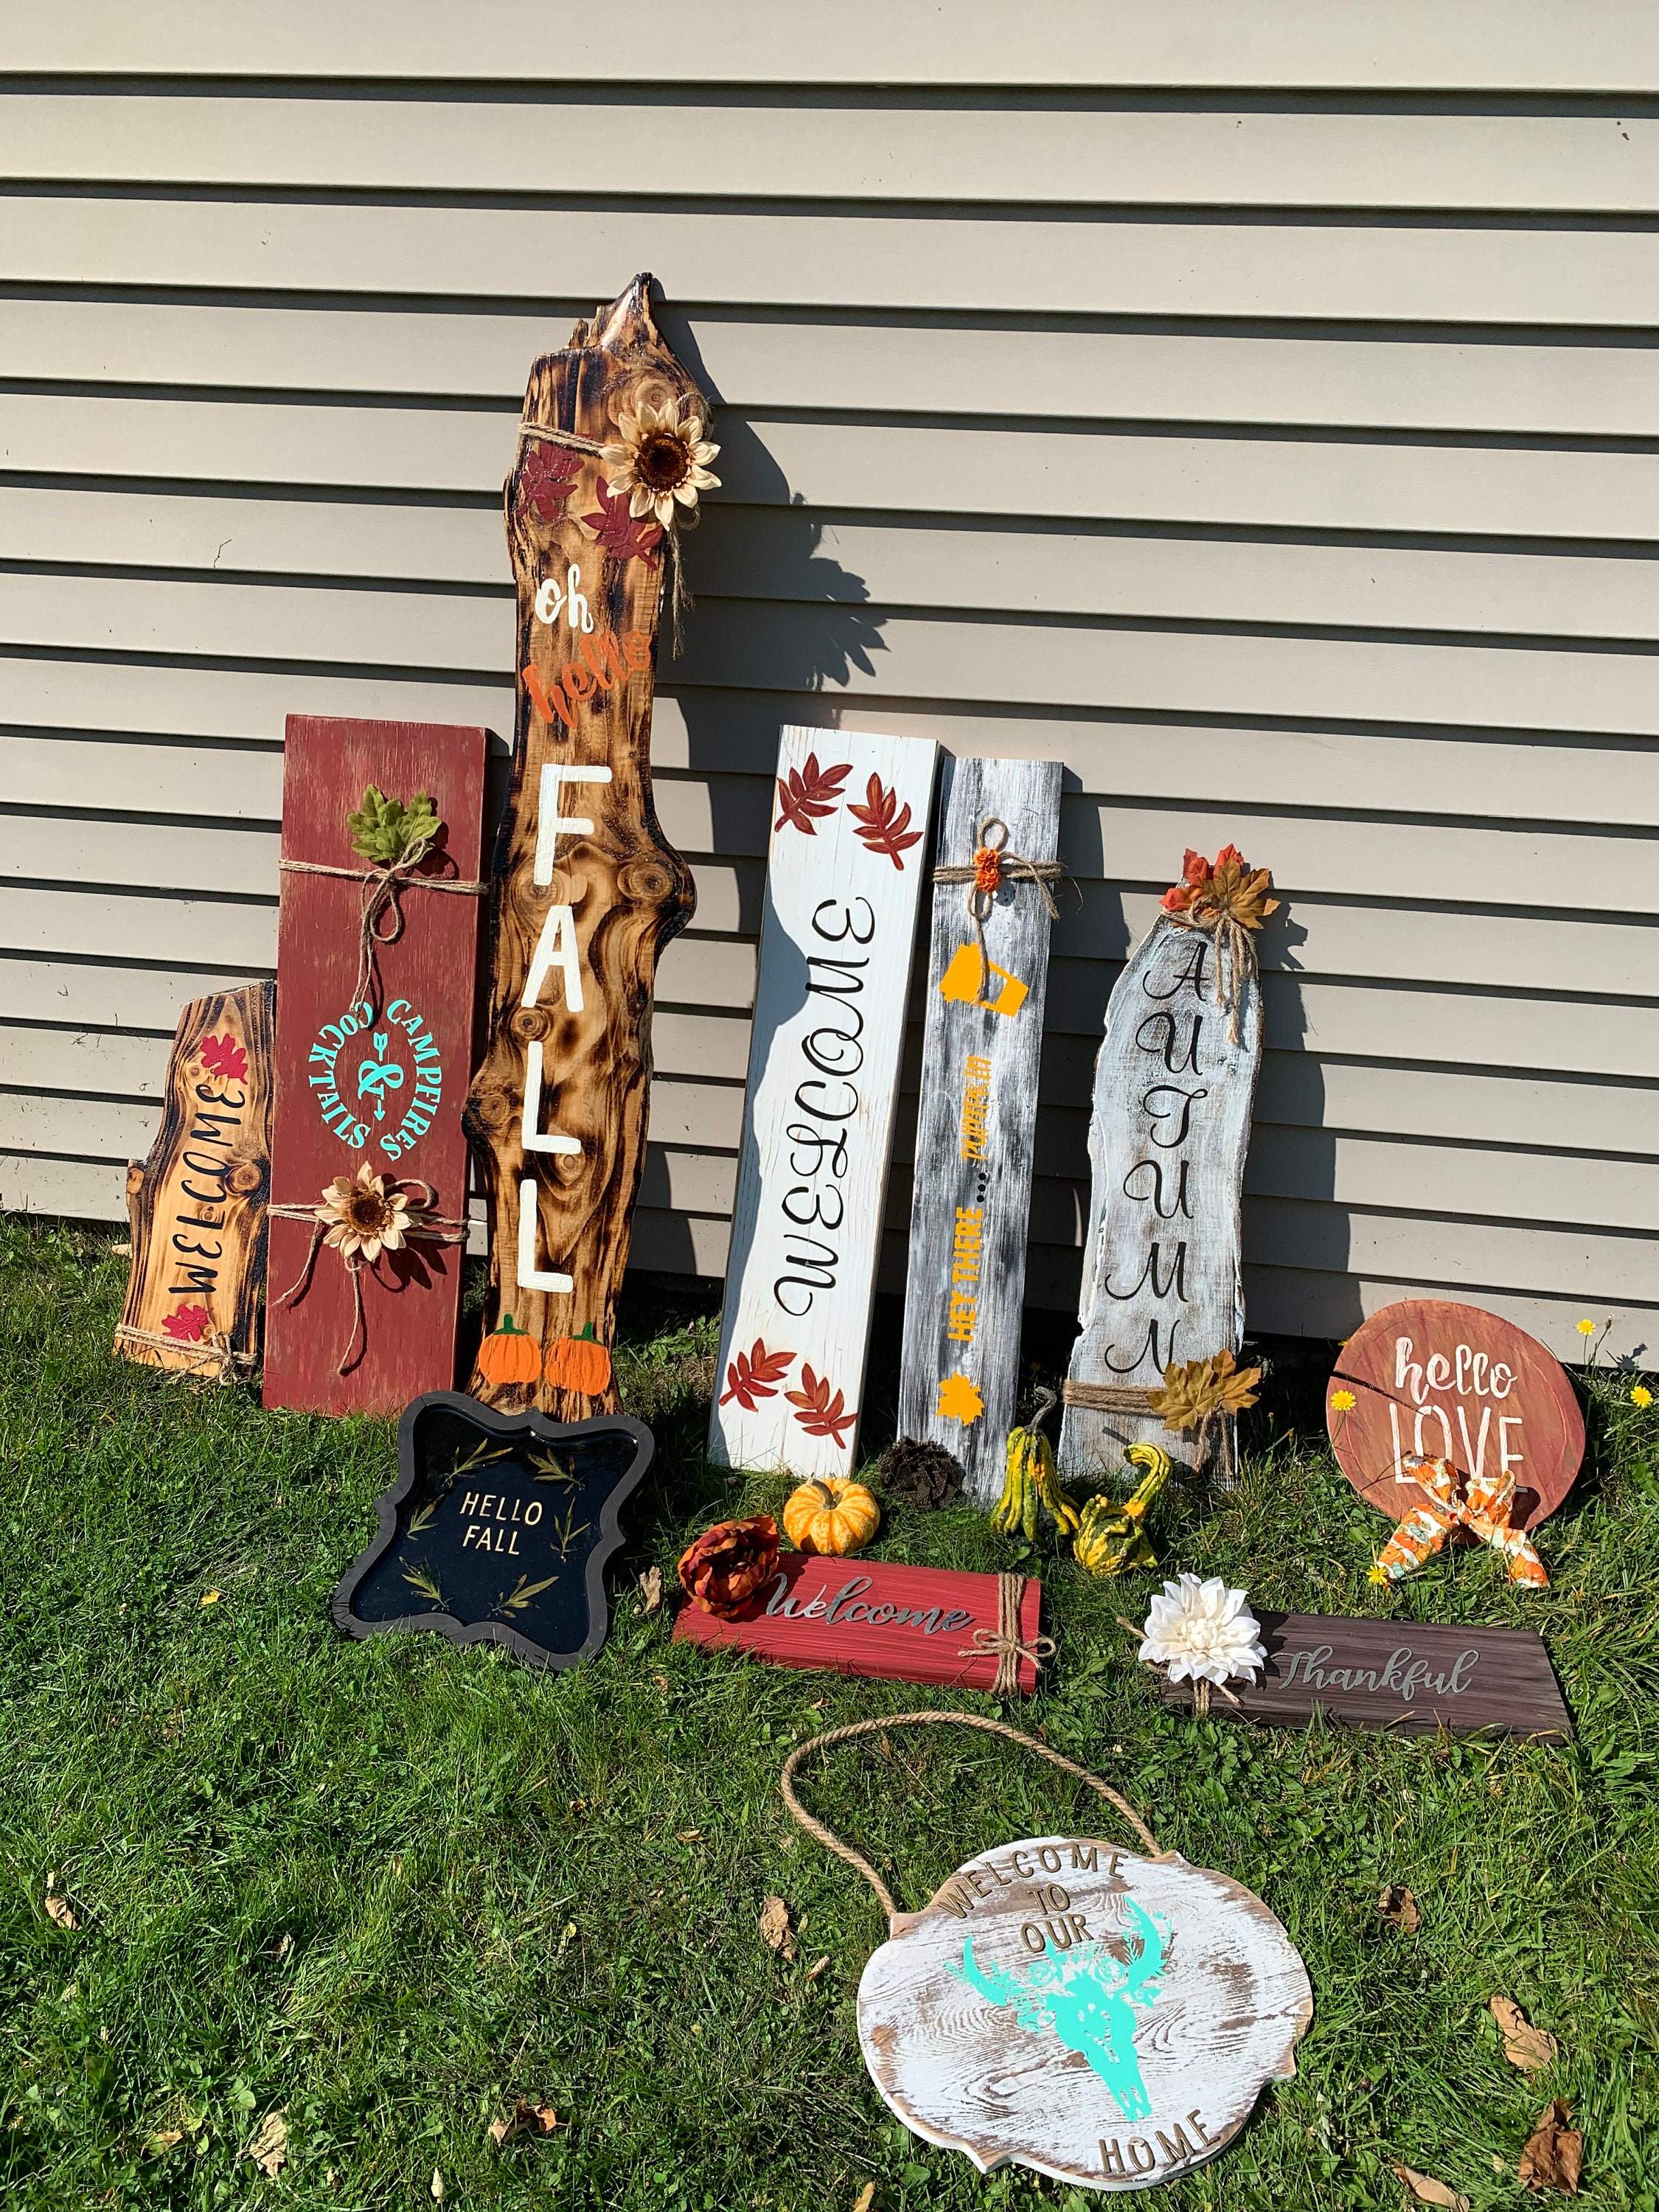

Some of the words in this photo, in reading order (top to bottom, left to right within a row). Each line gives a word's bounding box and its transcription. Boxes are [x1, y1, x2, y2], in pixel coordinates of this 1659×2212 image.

[535, 563, 594, 633] oh
[522, 630, 653, 728] hello
[517, 764, 613, 1293] FALL
[308, 1001, 375, 1149] COCKTAILS
[358, 1060, 404, 1100] &
[380, 999, 442, 1162] CAMPFIRES
[773, 896, 876, 1317] WELCOME
[168, 1083, 246, 1295] WELCOME
[1105, 941, 1211, 1375] AUTUMN
[947, 1290, 977, 1342] HEY
[1395, 1336, 1518, 1405] hello
[1388, 1402, 1528, 1494] LOVE
[459, 1491, 543, 1526] HELLO
[462, 1525, 520, 1556] FALL
[765, 1571, 974, 1635] Welcome
[1270, 1644, 1480, 1702] Thankful
[937, 1843, 1129, 1919] WELCOME
[1027, 1882, 1071, 1916] TO
[1020, 1913, 1095, 1953] OUR
[1097, 2109, 1220, 2174] HOME
